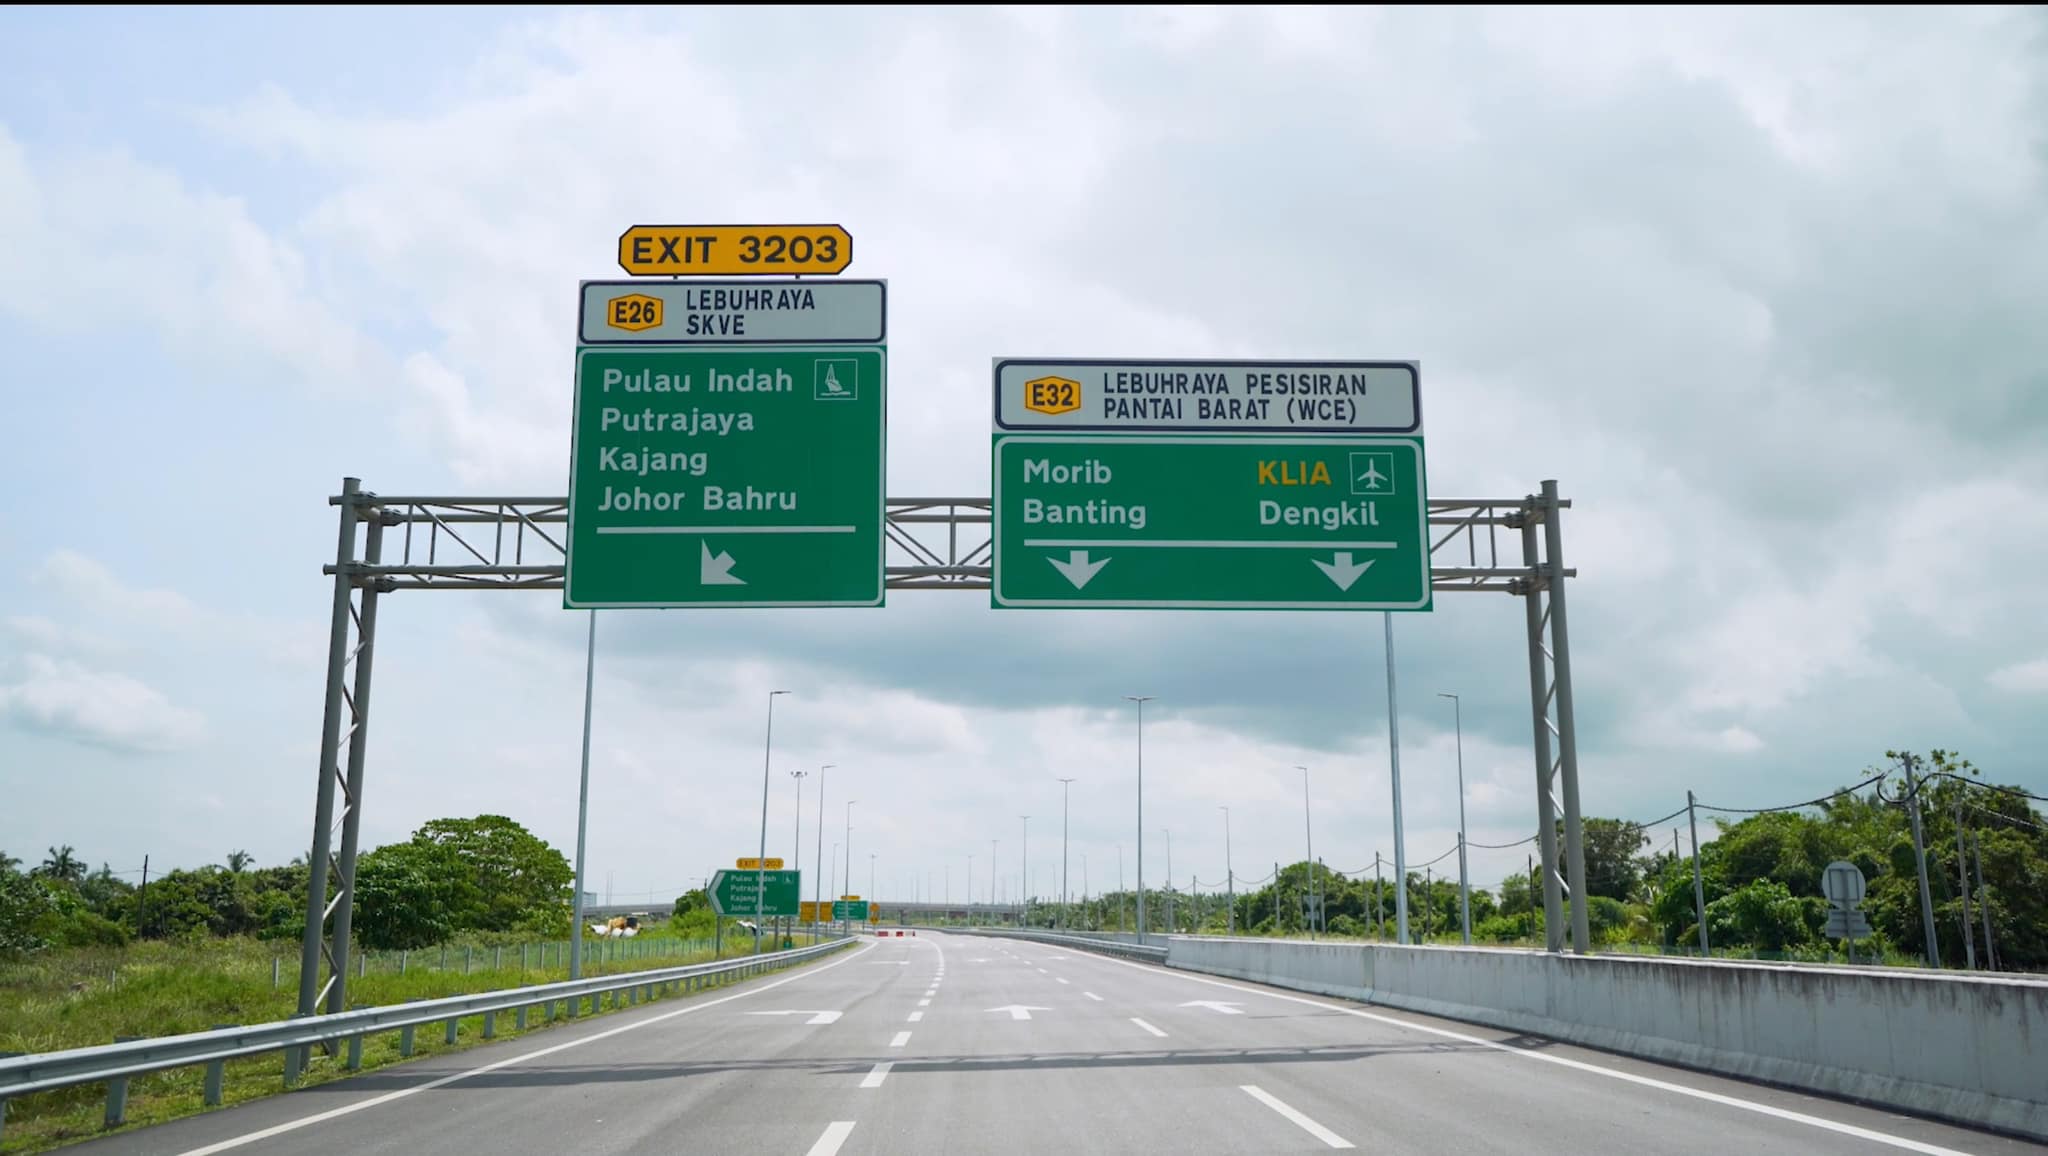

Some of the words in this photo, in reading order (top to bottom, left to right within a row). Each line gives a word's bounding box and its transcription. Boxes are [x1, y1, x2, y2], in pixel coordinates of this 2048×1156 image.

[633, 237, 717, 264] EXIT
[739, 236, 837, 263] 3203
[687, 290, 814, 310] LEBUHRAYA
[616, 301, 655, 324] E26
[687, 314, 744, 335] SKVE
[604, 369, 690, 392] Pulau
[709, 368, 792, 392] Indah
[1104, 373, 1229, 394] LEBUHRAYA
[1246, 374, 1365, 395] PESISIRAN
[1032, 384, 1074, 407] E32
[602, 408, 753, 436] Putrajaya
[1105, 398, 1181, 419] PANTAI
[1199, 399, 1270, 419] BARAT
[1287, 397, 1355, 424] (WCE)
[600, 447, 707, 475] Kajang
[1024, 459, 1111, 483] Morib
[1259, 461, 1331, 485] KLIA
[598, 487, 685, 510] Johor
[704, 486, 796, 510] Bahru
[1024, 499, 1145, 529] Banting
[1260, 501, 1378, 530] Dengkil
[731, 874, 752, 882] Pulau
